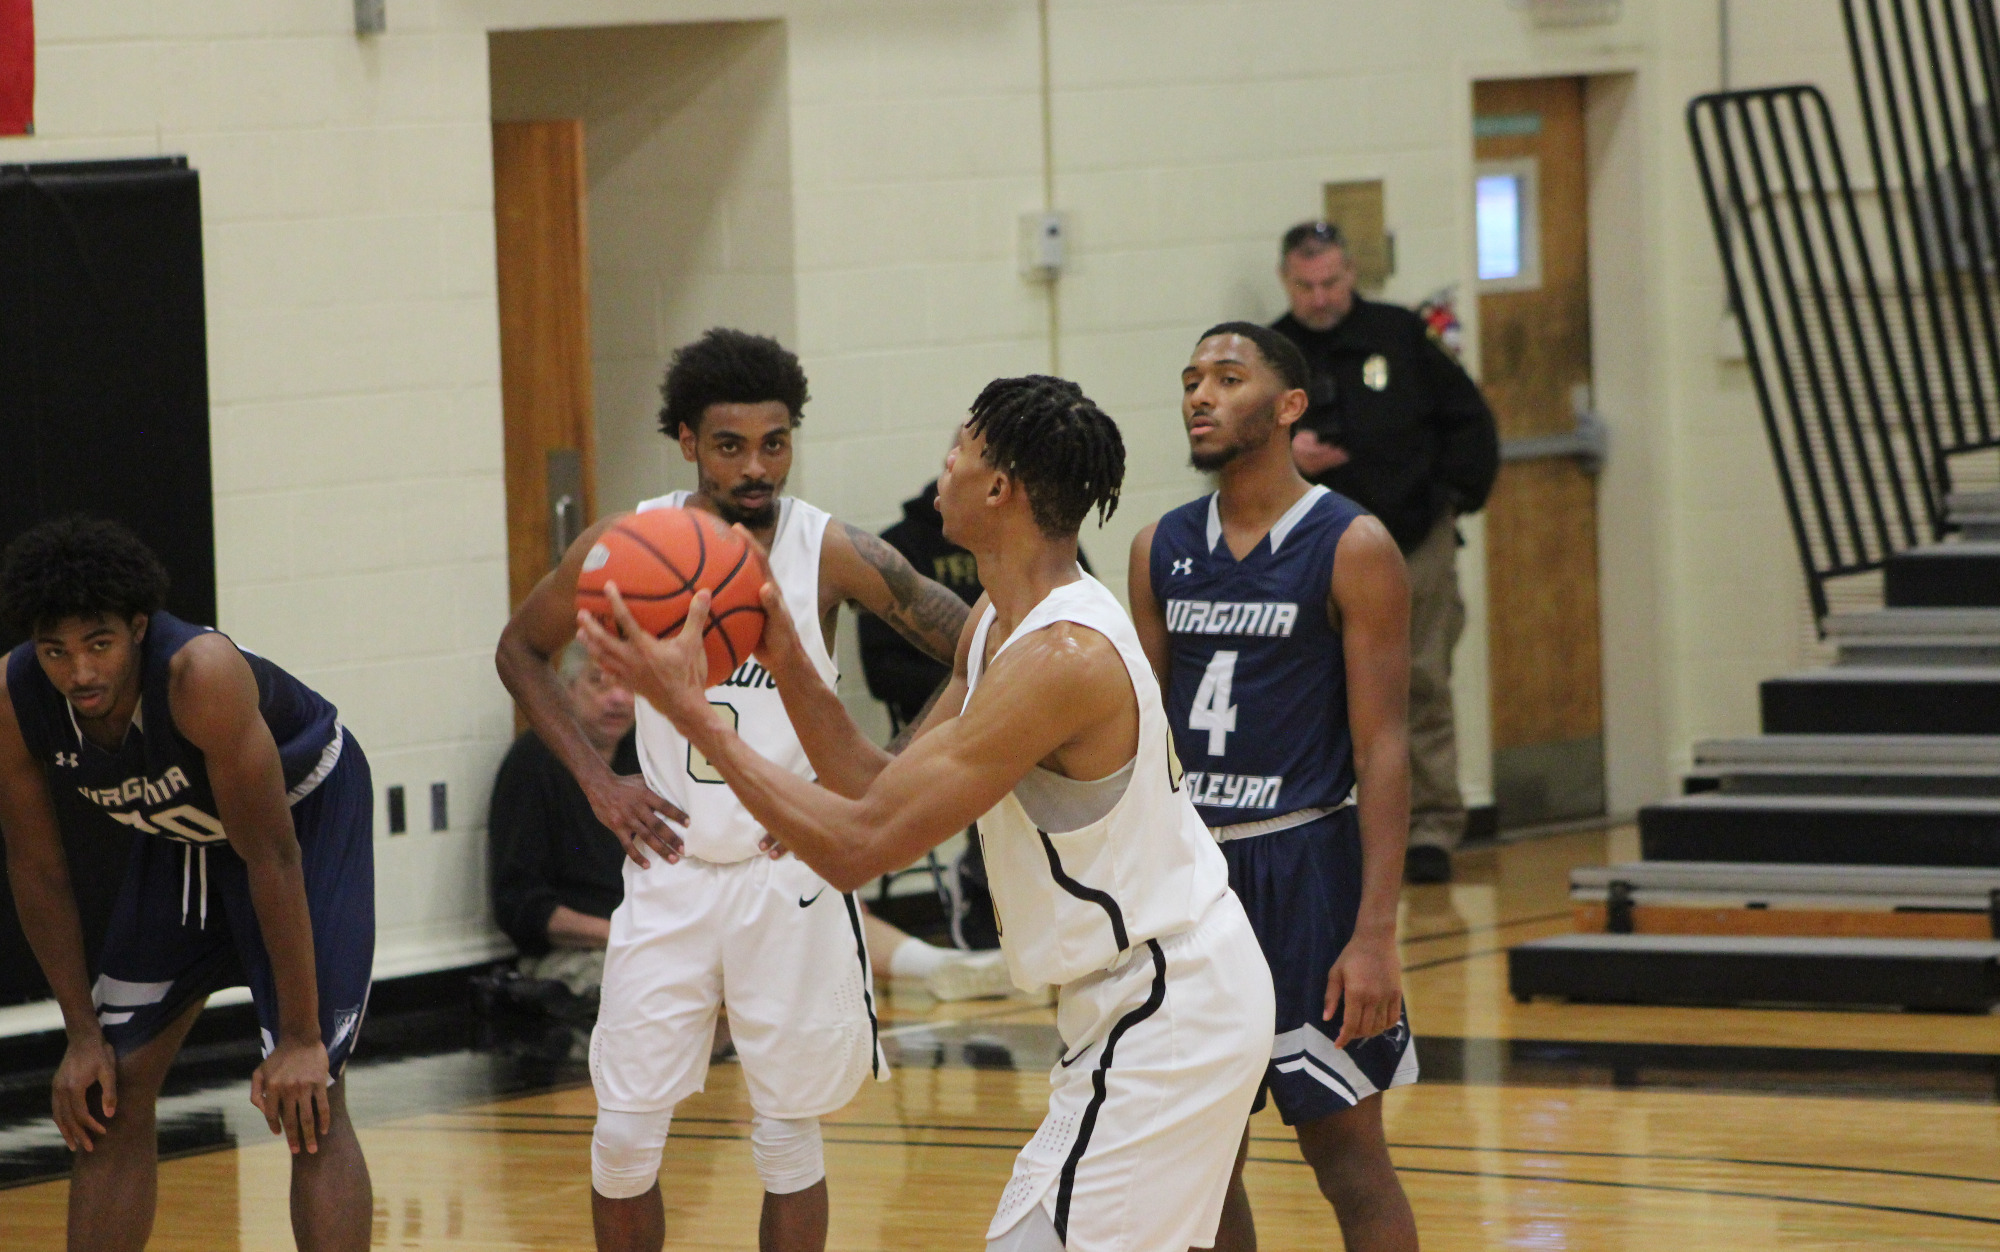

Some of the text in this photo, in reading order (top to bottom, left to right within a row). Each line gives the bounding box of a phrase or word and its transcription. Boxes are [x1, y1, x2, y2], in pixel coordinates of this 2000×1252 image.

[1166, 599, 1298, 637] VIRGINIA
[1188, 650, 1238, 756] 4
[78, 766, 191, 806] VIRGNIA
[1185, 771, 1283, 809] SLEYAN
